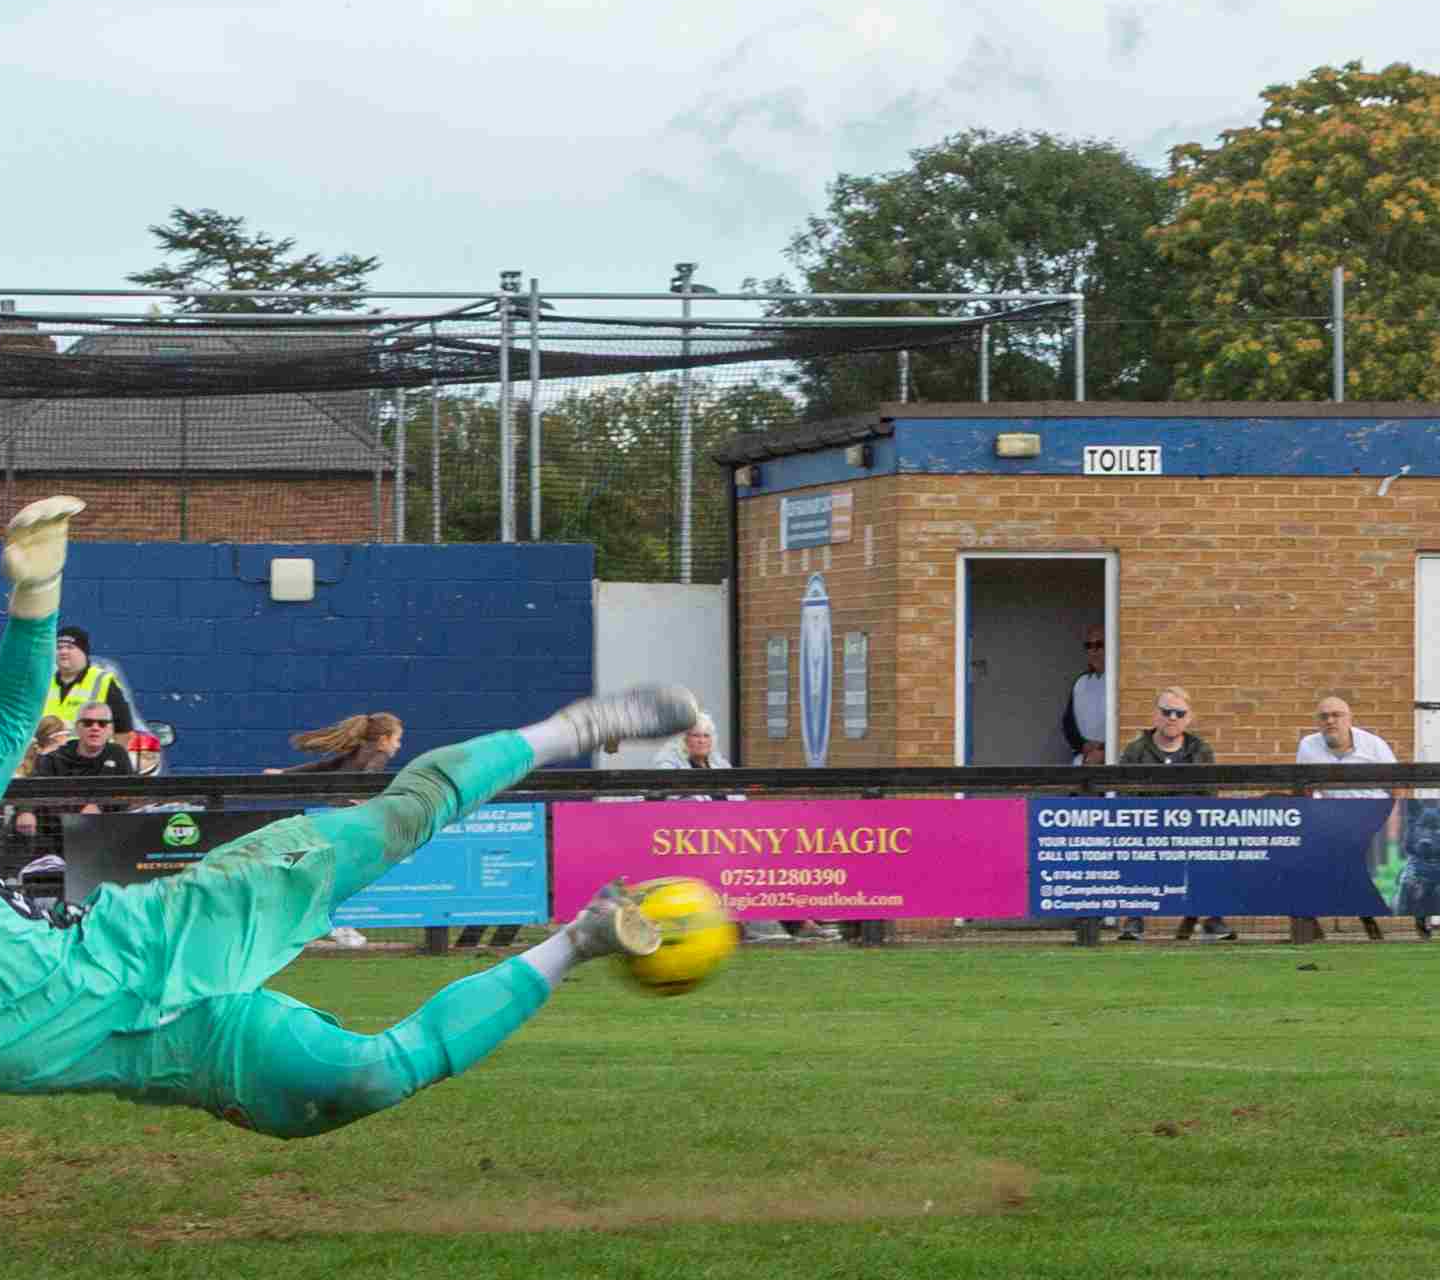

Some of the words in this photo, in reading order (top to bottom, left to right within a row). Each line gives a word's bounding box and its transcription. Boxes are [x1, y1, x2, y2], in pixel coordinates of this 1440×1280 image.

[1087, 448, 1158, 472] TOILET
[1038, 809, 1159, 828] COMPLETE
[1163, 809, 1193, 828] K9
[1197, 808, 1302, 827] TRAINING
[652, 828, 791, 856] SKINNY
[795, 827, 913, 855] MAGIC
[1038, 837, 1067, 847] YOUR
[1068, 837, 1112, 847] LEADING
[1113, 837, 1145, 847] LOCAL
[1146, 836, 1169, 847] DOG
[1171, 836, 1213, 847] TRAINER
[1241, 836, 1269, 846] YOUR
[1038, 850, 1064, 861] CALL
[1065, 851, 1080, 861] US
[1081, 851, 1115, 861] TODAY
[1116, 851, 1131, 861] TO
[1132, 851, 1157, 861] TAKE
[1158, 850, 1186, 861] YOUR
[1188, 850, 1237, 861] PROBLEM
[720, 868, 847, 886] 07521280390
[710, 891, 905, 912] Magic2025@outlook.com
[1054, 899, 1101, 911] Complete
[1101, 899, 1118, 910] K9
[1119, 899, 1160, 911] Training
